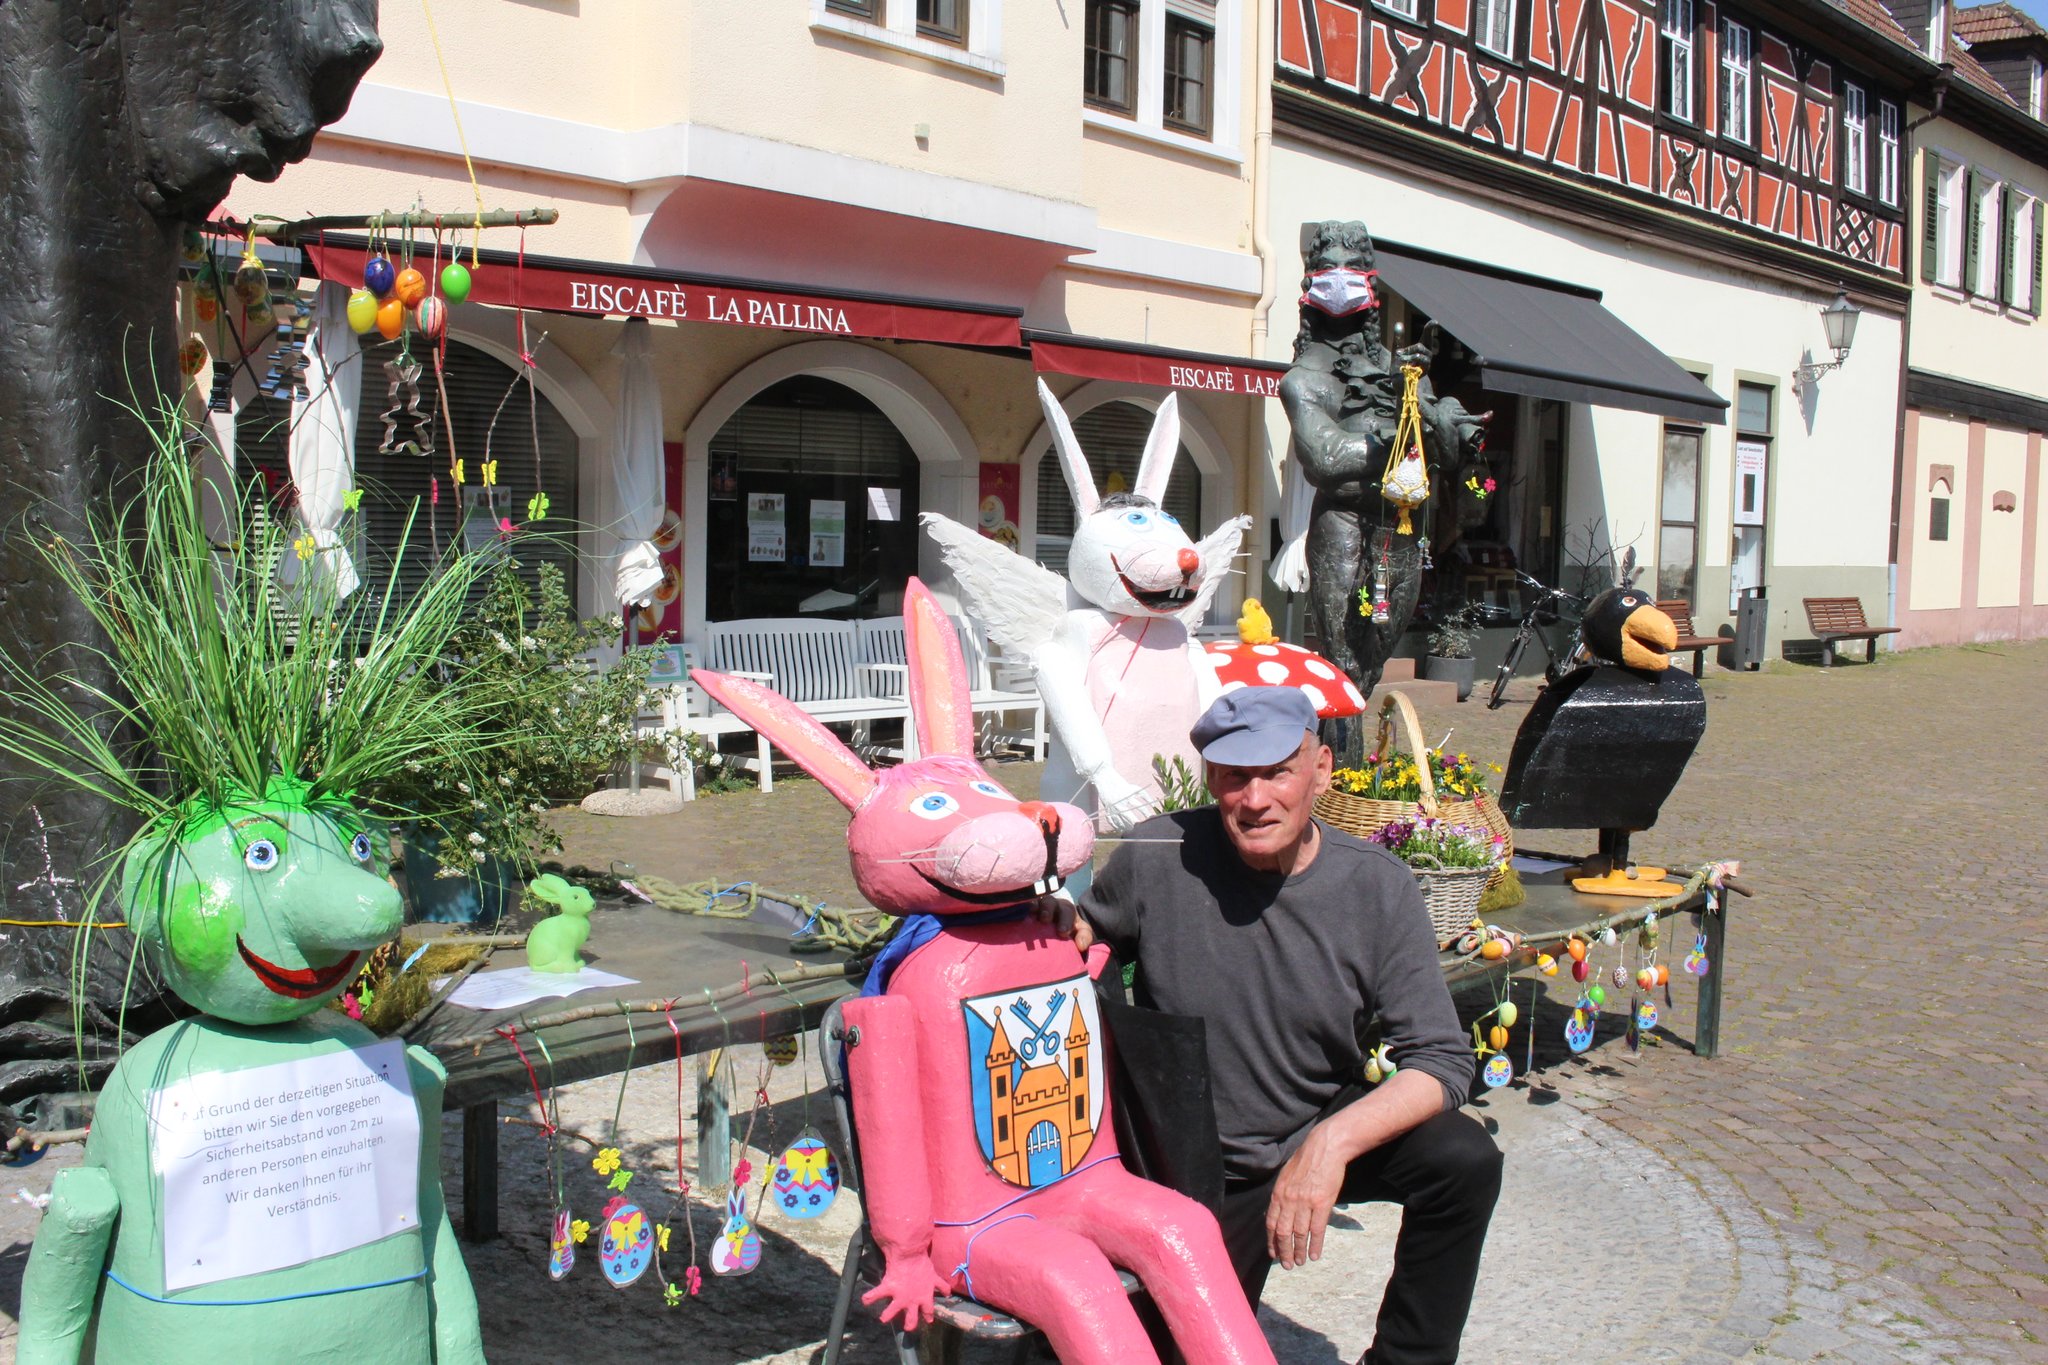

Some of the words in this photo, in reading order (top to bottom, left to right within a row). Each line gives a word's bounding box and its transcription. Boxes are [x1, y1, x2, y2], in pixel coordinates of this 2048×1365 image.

[570, 282, 687, 318] EISCAFÈ
[707, 295, 743, 324] LA
[747, 299, 852, 333] PALLINA
[1169, 366, 1235, 392] EISCAFÈ
[1244, 374, 1265, 395] LA
[208, 1099, 250, 1117] Grund
[254, 1095, 275, 1109] der
[278, 1081, 343, 1104] derzeitigen
[345, 1071, 390, 1089] Situation
[204, 1123, 243, 1141] bitten
[246, 1118, 265, 1132] wir
[270, 1114, 288, 1128] Sie
[291, 1108, 313, 1122] den
[316, 1094, 381, 1117] vorgegeben
[206, 1128, 324, 1163] Sicherheitsabstand
[327, 1124, 347, 1137] von
[350, 1119, 369, 1131] 2m
[371, 1115, 384, 1127] zu
[202, 1164, 257, 1185] anderen
[261, 1152, 318, 1173] Personen
[321, 1134, 387, 1160] einzuhalten.
[225, 1189, 249, 1204] Wir
[253, 1180, 299, 1199] danken
[302, 1171, 336, 1188] Ihnen
[338, 1166, 354, 1180] für
[356, 1161, 372, 1174] ihr
[267, 1191, 341, 1218] Verständnis.
